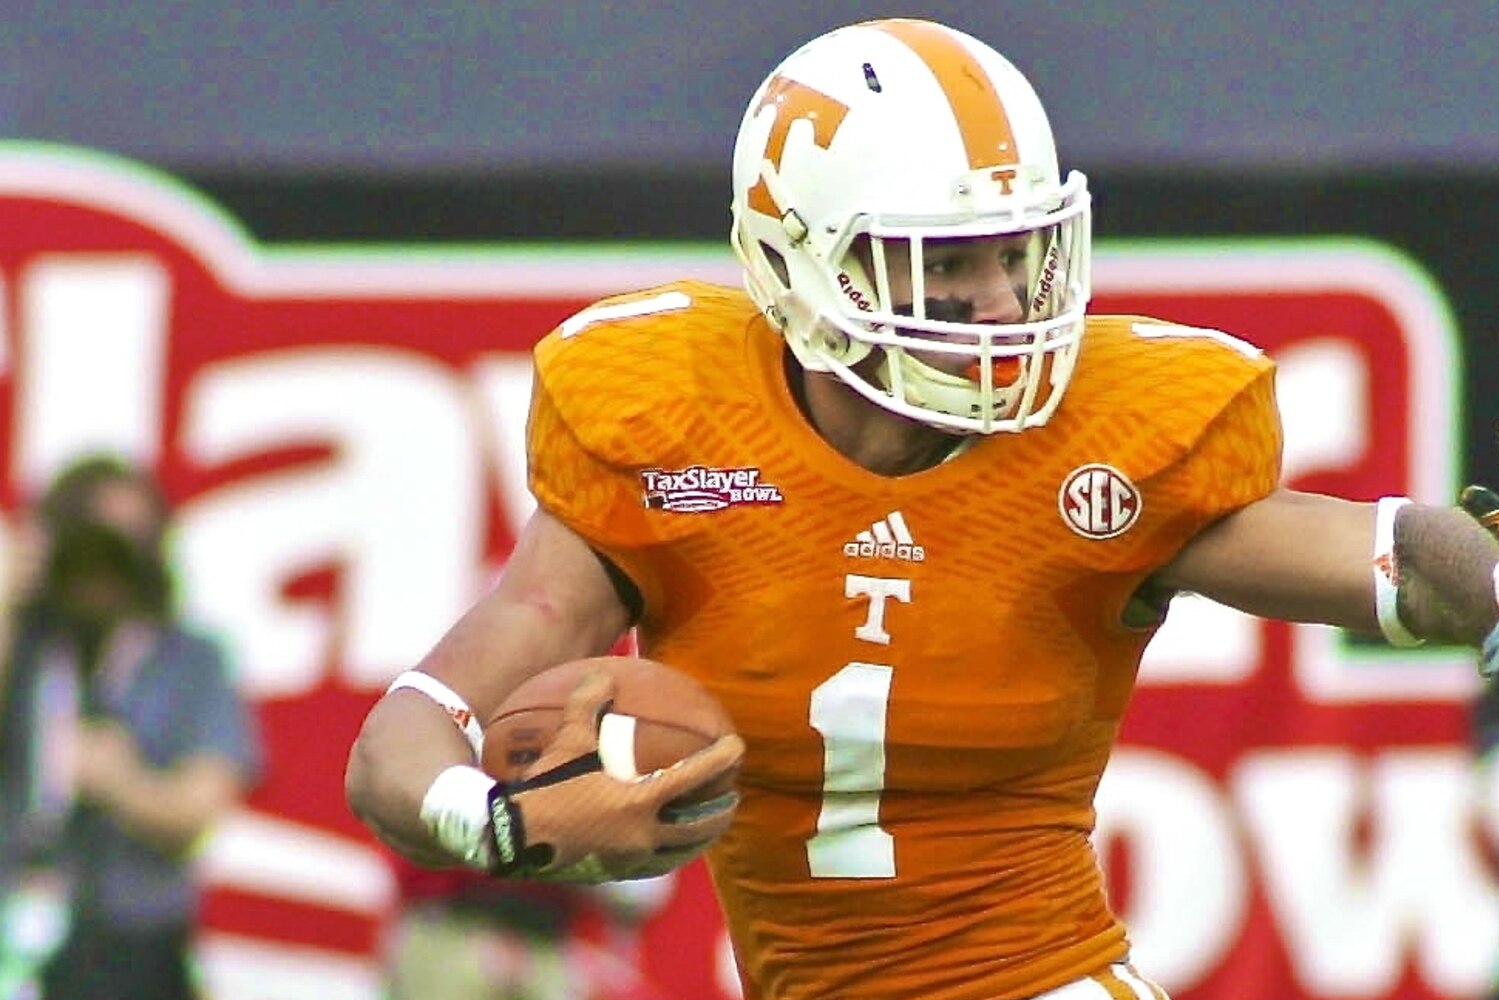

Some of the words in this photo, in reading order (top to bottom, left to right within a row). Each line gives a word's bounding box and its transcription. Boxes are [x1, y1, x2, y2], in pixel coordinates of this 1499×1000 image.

[991, 169, 1016, 195] T
[642, 468, 759, 493] TaxSlayer
[729, 487, 783, 502] BOWL
[1067, 470, 1132, 532] SEC
[843, 541, 925, 562] adidas
[844, 573, 912, 646] T
[805, 661, 897, 879] 1
